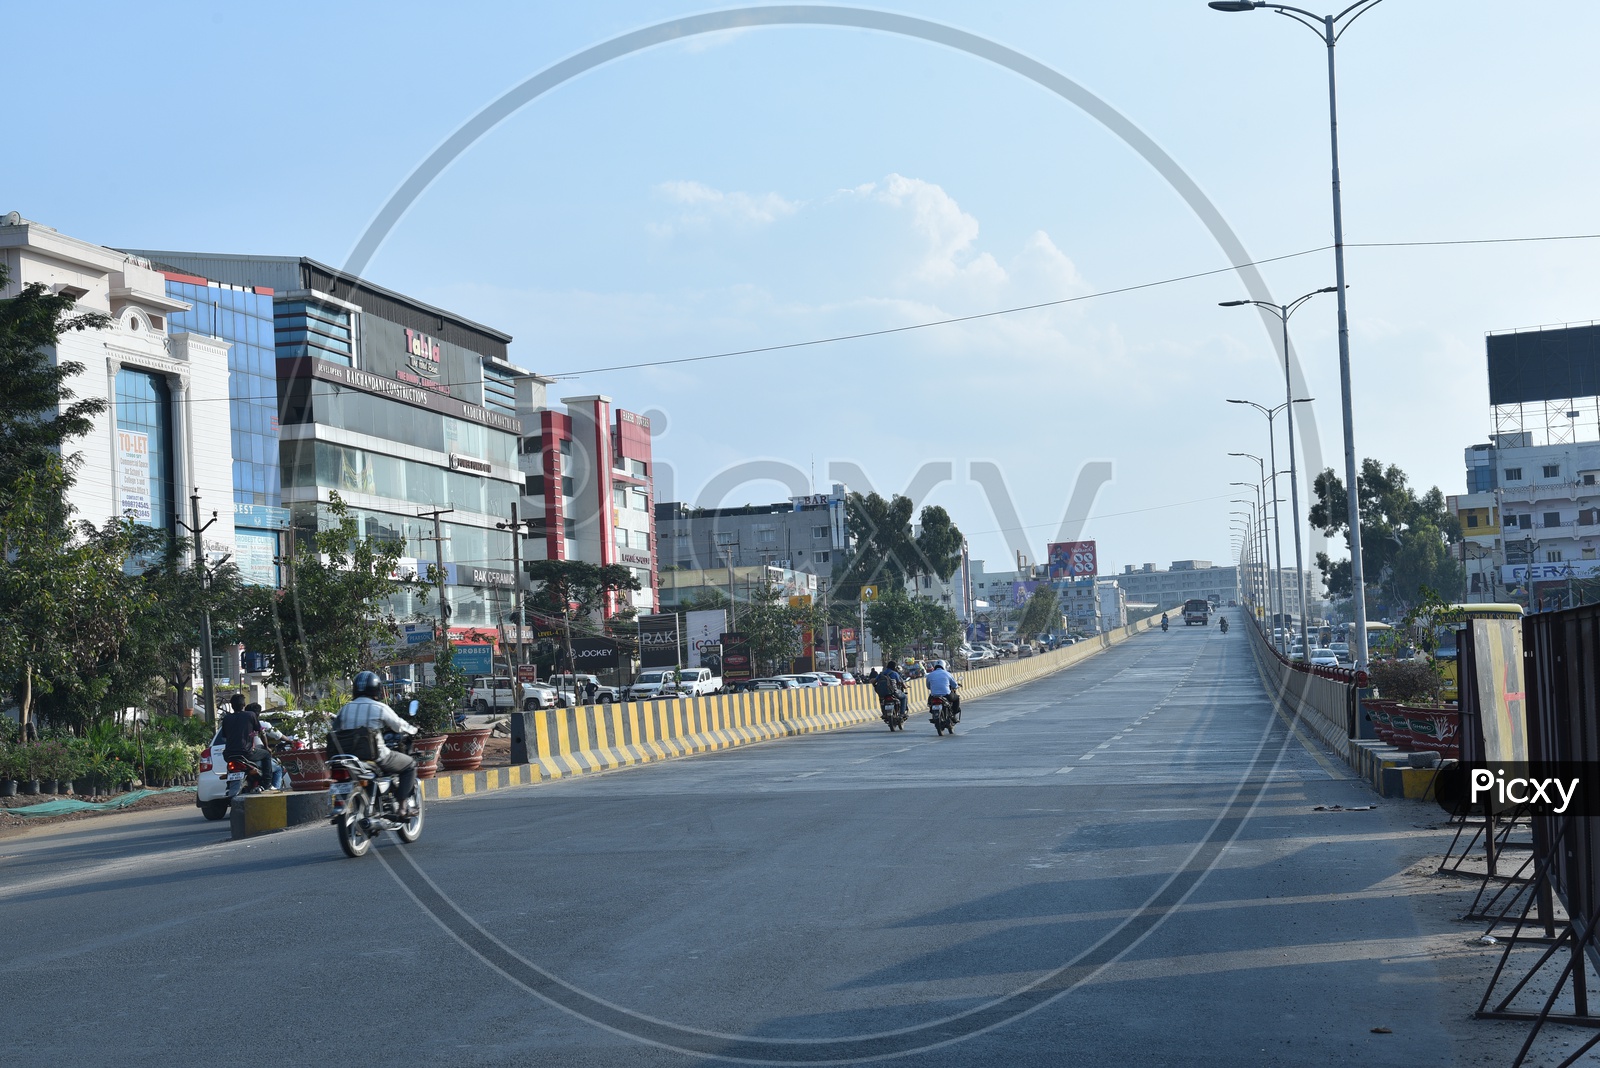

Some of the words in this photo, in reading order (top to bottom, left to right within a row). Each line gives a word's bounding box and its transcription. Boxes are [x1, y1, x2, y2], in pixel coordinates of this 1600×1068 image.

[406, 328, 440, 363] Tabla
[386, 381, 428, 405] CONSTRUCTIONS
[119, 433, 147, 454] TO-LET
[804, 496, 828, 505] BAR
[474, 569, 487, 583] RAK
[642, 631, 674, 645] RAK
[578, 649, 612, 658] JOCKEY
